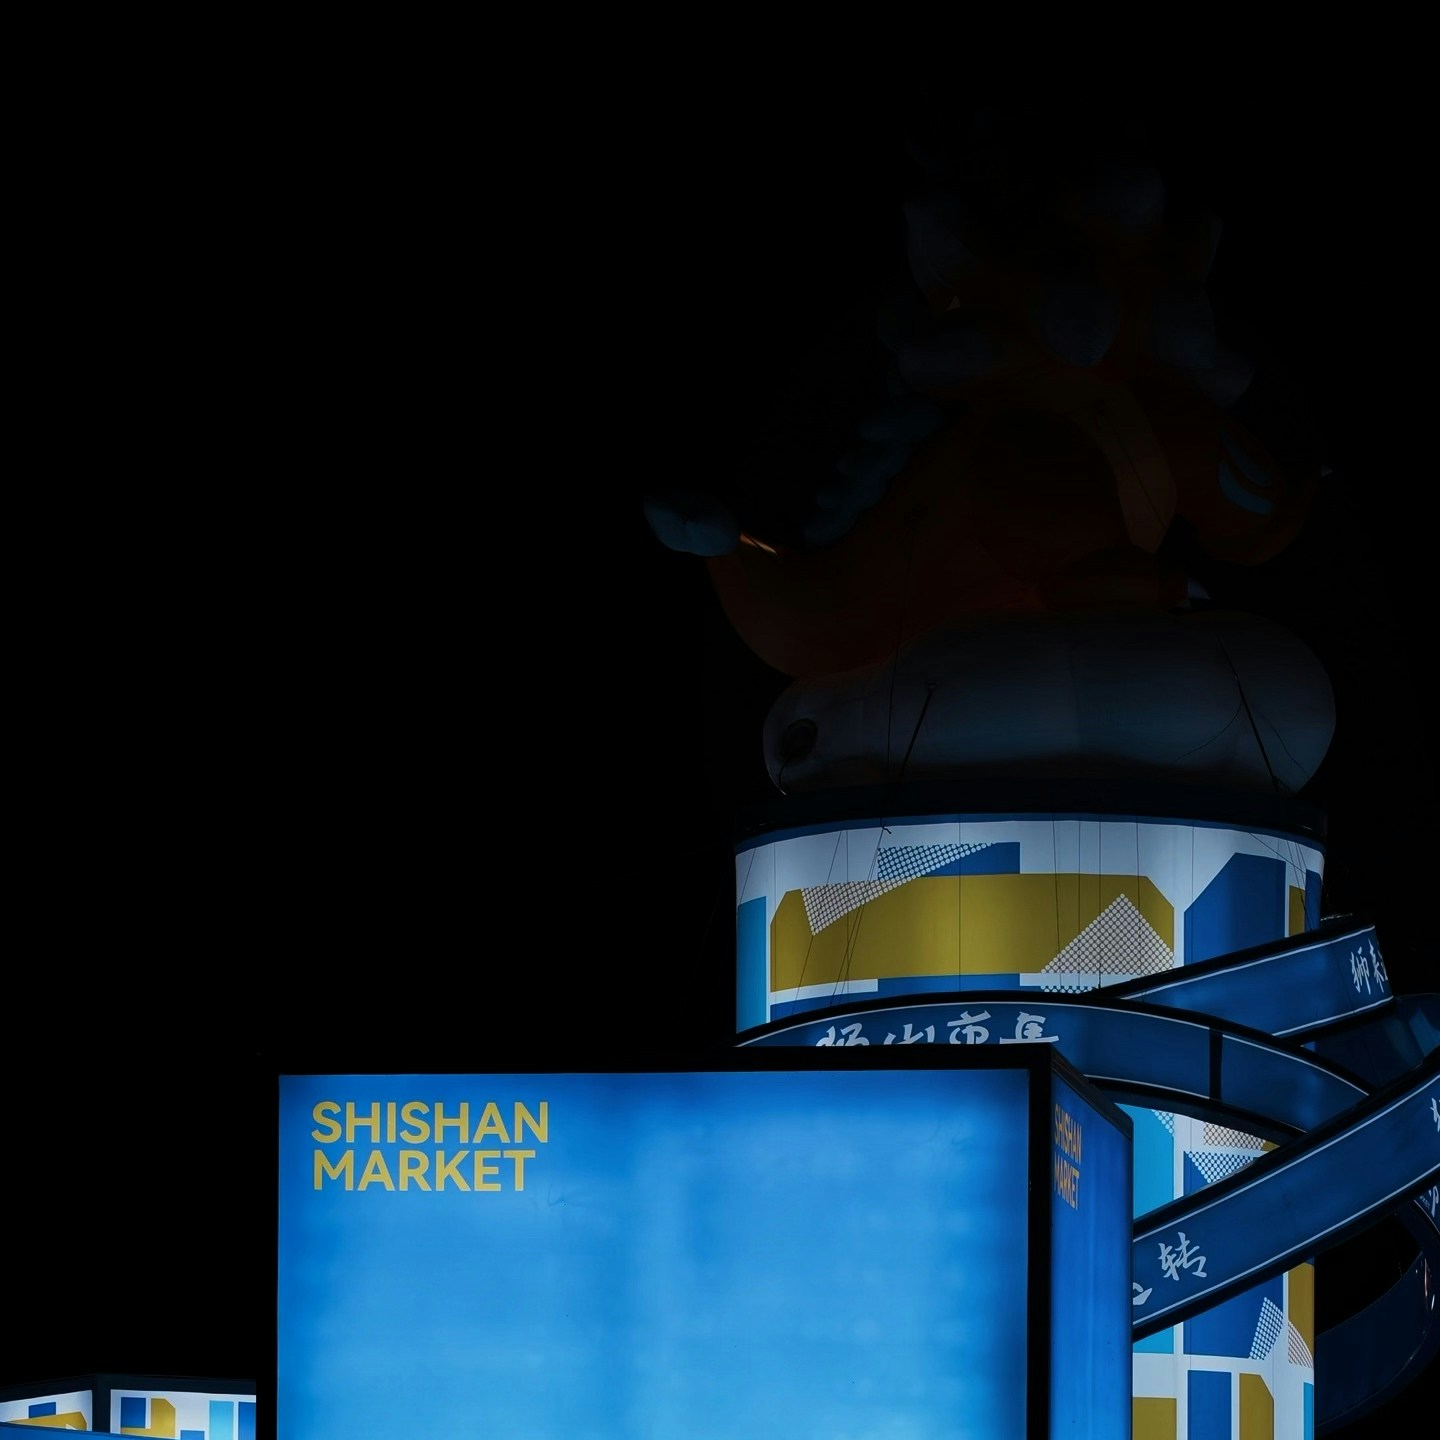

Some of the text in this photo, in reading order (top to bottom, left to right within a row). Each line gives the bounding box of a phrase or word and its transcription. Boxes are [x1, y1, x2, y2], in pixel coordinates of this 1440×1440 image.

[311, 1101, 549, 1144] SHISHAN
[1053, 1103, 1082, 1167] SHISHAN
[313, 1149, 536, 1192] MARKET
